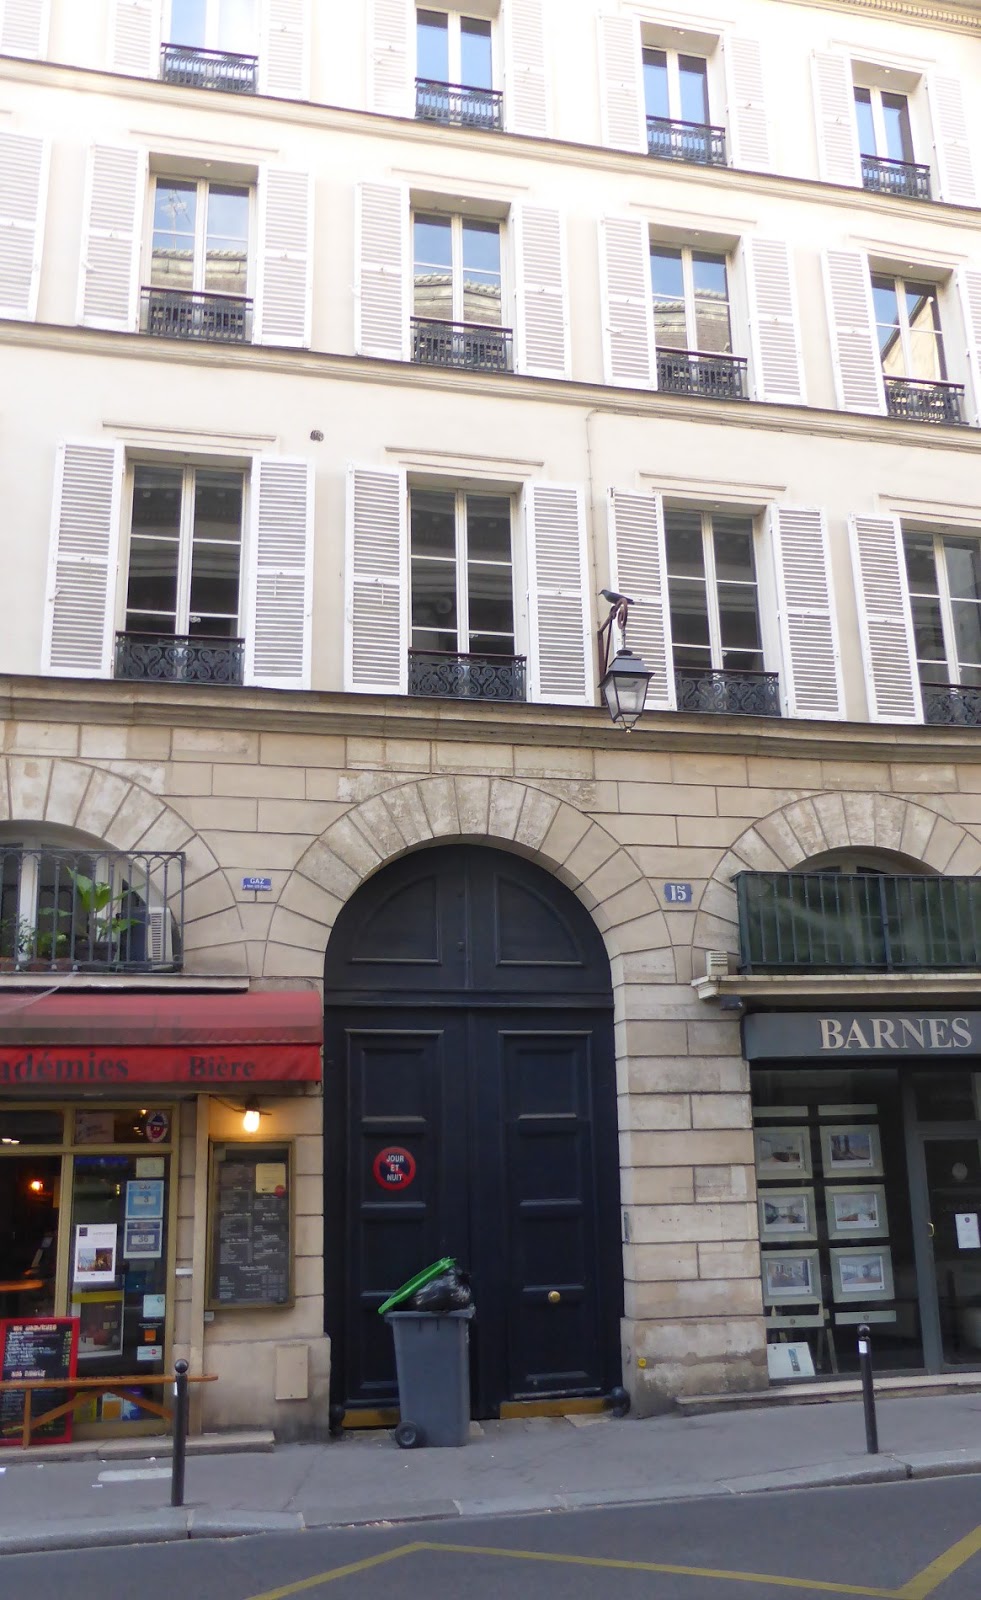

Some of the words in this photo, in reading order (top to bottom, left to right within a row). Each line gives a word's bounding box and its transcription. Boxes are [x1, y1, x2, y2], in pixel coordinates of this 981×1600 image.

[670, 885, 687, 901] 15
[819, 1017, 973, 1050] BARNES
[189, 1055, 256, 1078] Bière
